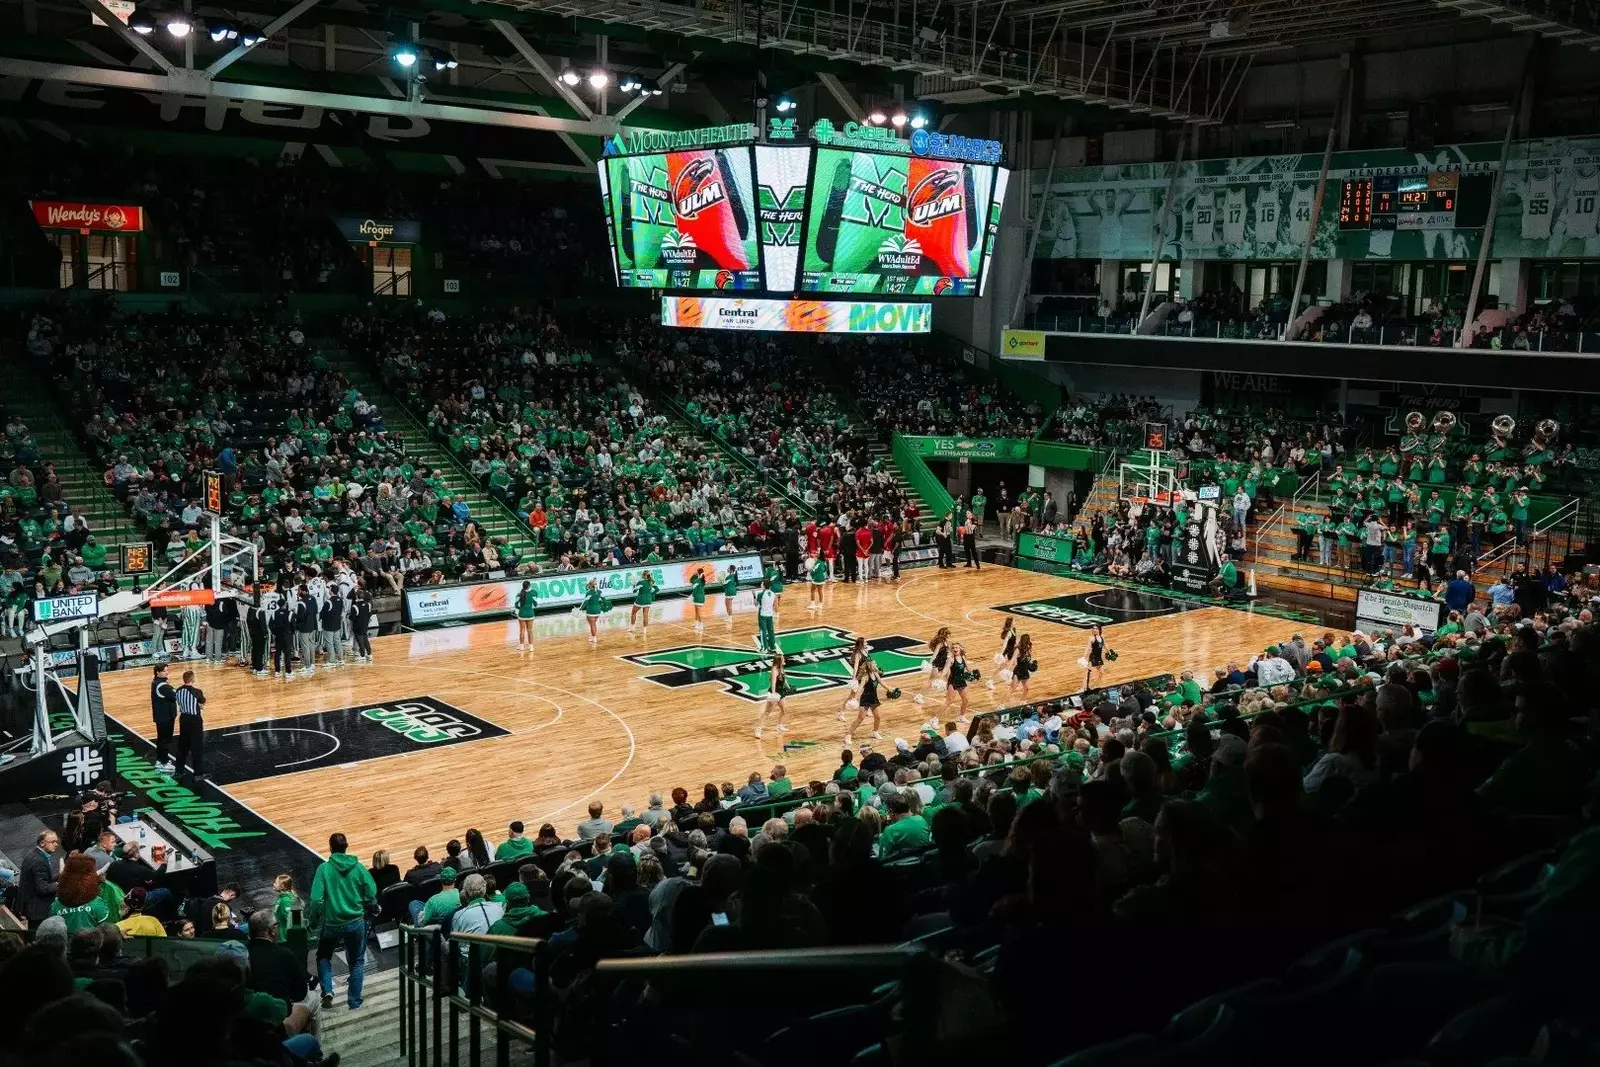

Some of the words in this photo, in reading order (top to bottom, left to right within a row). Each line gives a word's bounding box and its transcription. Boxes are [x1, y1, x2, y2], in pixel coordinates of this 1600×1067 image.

[629, 128, 699, 154] MOUNTAIN
[700, 123, 751, 145] HEALTH
[844, 122, 898, 142] CABELL
[950, 135, 1002, 154] MARY'S
[930, 146, 966, 158] MEDICAL
[966, 152, 1000, 162] CENTER
[1350, 166, 1428, 178] HENDERSON
[1436, 162, 1490, 173] CENTER
[630, 180, 649, 196] THE
[649, 186, 668, 200] HERD
[852, 178, 876, 194] THE
[876, 186, 901, 203] HERD
[679, 182, 723, 214] ULM
[1403, 192, 1426, 202] 14:27
[914, 194, 962, 222] ULM
[1446, 200, 1452, 209] 8
[1529, 200, 1548, 215] 55
[1575, 198, 1594, 214] 10
[48, 204, 102, 226] Wendy's
[760, 210, 778, 220] THE
[1198, 212, 1211, 224] 20
[1229, 210, 1242, 223] 17
[1261, 209, 1275, 222] 16
[1296, 208, 1310, 221] 44
[360, 220, 394, 240] Kroger
[662, 250, 696, 258] WVAdultEd
[878, 254, 920, 264] WVAdultEd
[163, 275, 178, 284] 102
[445, 281, 458, 292] 103
[886, 283, 905, 293] 14:27
[719, 307, 758, 317] Central
[849, 304, 922, 332] MOVE
[934, 440, 954, 449] YES
[128, 558, 144, 570] 25
[532, 578, 586, 600] MOVE
[612, 568, 664, 590] GAE
[52, 596, 93, 609] UNITED
[419, 599, 450, 608] Central
[1364, 593, 1377, 602] The
[52, 606, 82, 617] BANK
[268, 600, 277, 610] 13
[787, 644, 874, 664] HER
